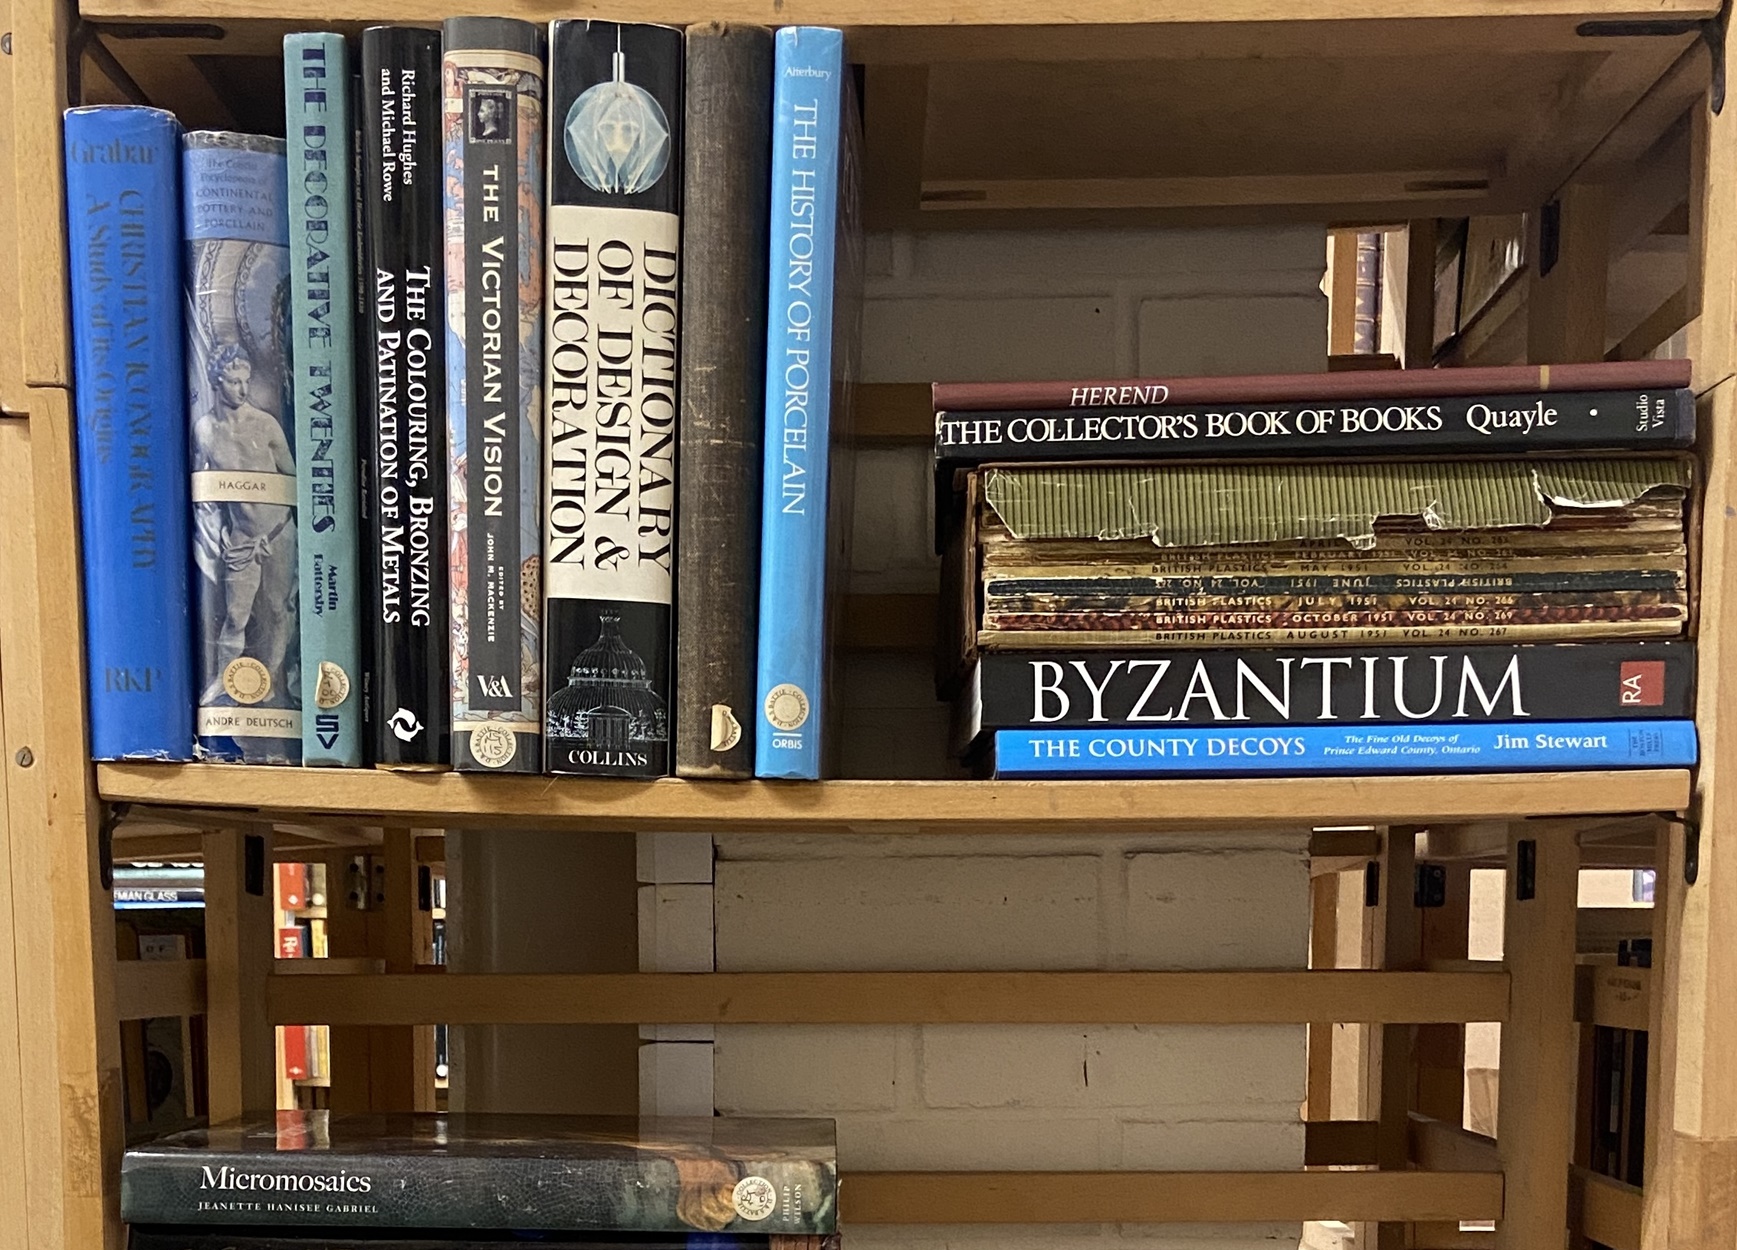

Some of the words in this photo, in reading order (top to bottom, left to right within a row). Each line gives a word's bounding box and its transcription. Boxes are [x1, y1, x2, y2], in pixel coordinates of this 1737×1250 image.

[303, 42, 327, 113] THE
[381, 68, 396, 96] and
[784, 65, 832, 81] Atterbury
[401, 69, 417, 126] Richard
[382, 100, 396, 158] Michael
[791, 98, 818, 160] THE
[71, 138, 157, 165] Grabar
[398, 130, 417, 185] Hughes
[196, 187, 273, 200] CONTINENTAL
[382, 161, 396, 202] Rowe
[482, 164, 499, 222] THE
[197, 203, 243, 214] POTTERY
[248, 207, 273, 217] AND
[204, 219, 265, 231] PORCELAIN
[303, 125, 332, 348] DECORATIVE
[788, 169, 816, 298] HISTORY
[119, 189, 149, 348] CHRISTIAN
[597, 239, 635, 310] OF
[376, 267, 396, 323] AND
[405, 265, 431, 321] THE
[481, 235, 504, 403] VICTORIAN
[786, 300, 812, 342] OF
[377, 330, 400, 480] PATINATION
[405, 328, 432, 487] COLOURING,
[550, 237, 589, 571] DECORATION
[638, 241, 677, 577] DICTIONARY
[1070, 385, 1169, 407] HEREND
[1636, 393, 1649, 432] Studio
[1652, 398, 1665, 427] Vista
[594, 323, 633, 522] DESIGN
[781, 348, 810, 516] PORCELAIN
[940, 420, 1002, 445] THE
[1006, 414, 1199, 443] COLLECTOR'S
[1205, 411, 1292, 438] BOOK
[1295, 409, 1335, 434] OF
[1340, 406, 1443, 433] BOOKS
[1466, 400, 1558, 435] Quayle
[309, 364, 336, 534] TWENTIES
[483, 411, 506, 517] VISION
[218, 480, 266, 492] HAGGAR
[380, 487, 398, 521] OF
[409, 496, 434, 628] BRONZING
[487, 532, 495, 561] JOHN
[594, 535, 631, 573] &
[1295, 550, 1363, 558] FEBRUARY
[380, 525, 404, 624] METALS
[487, 565, 495, 578] M.
[1152, 565, 1202, 573] BRITISH
[1209, 564, 1267, 573] PLASTICS
[1300, 564, 1328, 572] MAY
[1341, 563, 1368, 571] 1951
[1211, 579, 1222, 588] 24
[1290, 578, 1317, 588] 1951
[1332, 577, 1370, 588] JUNE
[1396, 578, 1455, 587] PLASTICS
[312, 554, 324, 618] Battersby
[328, 565, 338, 610] Martin
[1156, 597, 1206, 606] BRITISH
[1298, 597, 1337, 606] JULY
[1350, 597, 1377, 606] 1951
[1445, 597, 1457, 605] 24
[1466, 596, 1489, 605] NO.
[487, 581, 495, 642] MACKENZIE
[499, 600, 504, 610] BY
[1156, 615, 1206, 624] BRITISH
[1213, 615, 1272, 624] PLASTICS
[1292, 613, 1358, 622] OCTOBER
[1368, 613, 1393, 622] 1951
[1443, 612, 1455, 620] 24
[1464, 612, 1489, 620] NO.
[1494, 611, 1513, 619] 269
[1156, 632, 1206, 640] BRITISH
[1212, 632, 1271, 640] PLASTICS
[1286, 630, 1348, 639] AUGUST
[1360, 629, 1387, 638] 1951
[1440, 629, 1450, 637] 24
[1490, 627, 1507, 636] 267
[104, 667, 160, 693] RKP
[476, 674, 513, 698] V&A
[1029, 654, 1530, 722] BYZANTIUM
[1622, 674, 1642, 704] RA
[205, 717, 240, 727] ANDRE
[246, 718, 293, 729] DEUTSCH
[1344, 735, 1362, 743] The
[1366, 735, 1388, 743] Fine
[1391, 735, 1410, 743] Old
[1413, 734, 1446, 744] Decoys
[1449, 734, 1460, 744] of
[568, 749, 648, 767] COLLINS
[772, 738, 803, 750] ORBIS
[1029, 739, 1080, 757] THE
[1088, 737, 1199, 757] COUNTY
[1207, 736, 1305, 757] DECOYS
[1323, 747, 1354, 755] Prince
[1358, 746, 1398, 755] Edward
[1400, 746, 1438, 756] County,
[1442, 745, 1481, 754] Ontario
[1493, 734, 1529, 750] Jim
[1535, 733, 1607, 749] Stewart
[143, 891, 178, 901] GLASS
[200, 1165, 372, 1193] Micromosaics
[197, 1202, 261, 1211] JEANETTE
[267, 1203, 321, 1212] HANISEE
[326, 1204, 379, 1213] GABRIEL
[782, 1186, 790, 1222] PHILIP
[794, 1184, 802, 1224] WILSON
